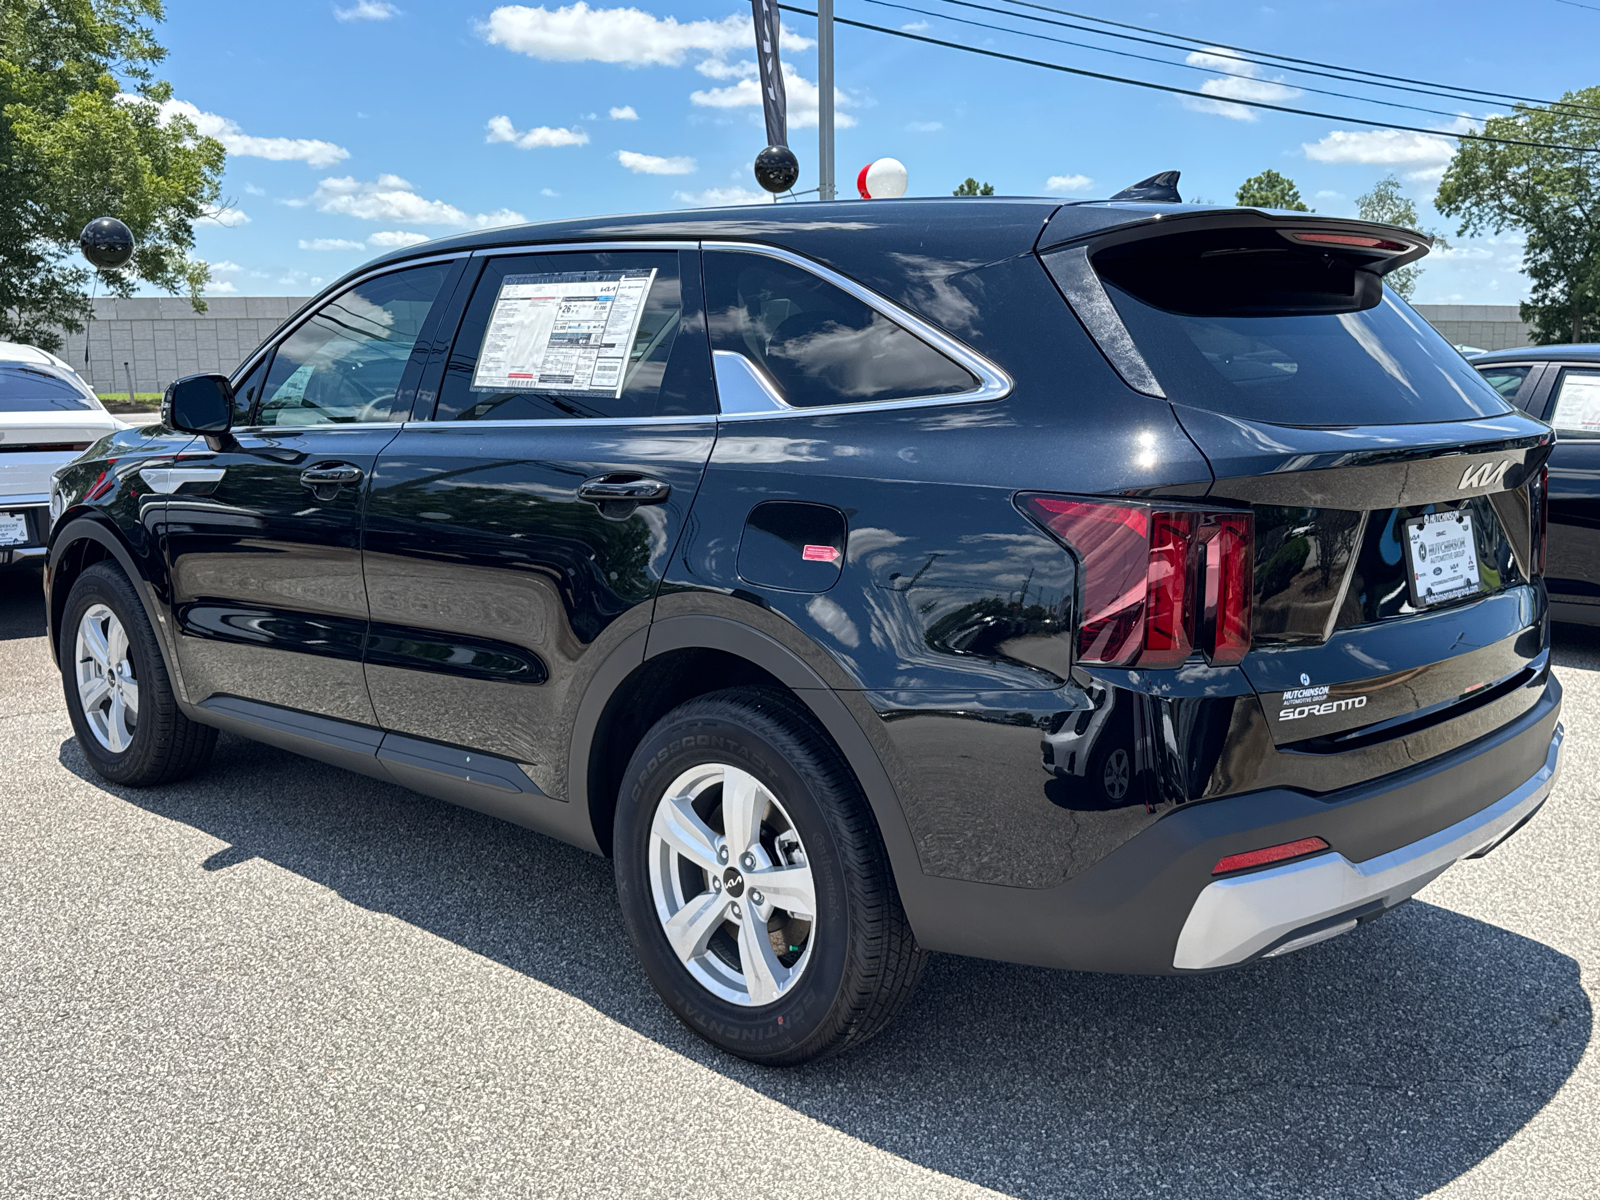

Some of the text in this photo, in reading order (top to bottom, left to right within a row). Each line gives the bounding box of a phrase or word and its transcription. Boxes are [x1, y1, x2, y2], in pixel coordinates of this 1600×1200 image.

[1457, 459, 1508, 489] KIA
[1428, 537, 1466, 556] HUTCHINSON
[1282, 686, 1330, 700] HUTCHINSON
[1283, 697, 1312, 706] AUTOMOTIVE
[1279, 696, 1367, 721] SORENTO
